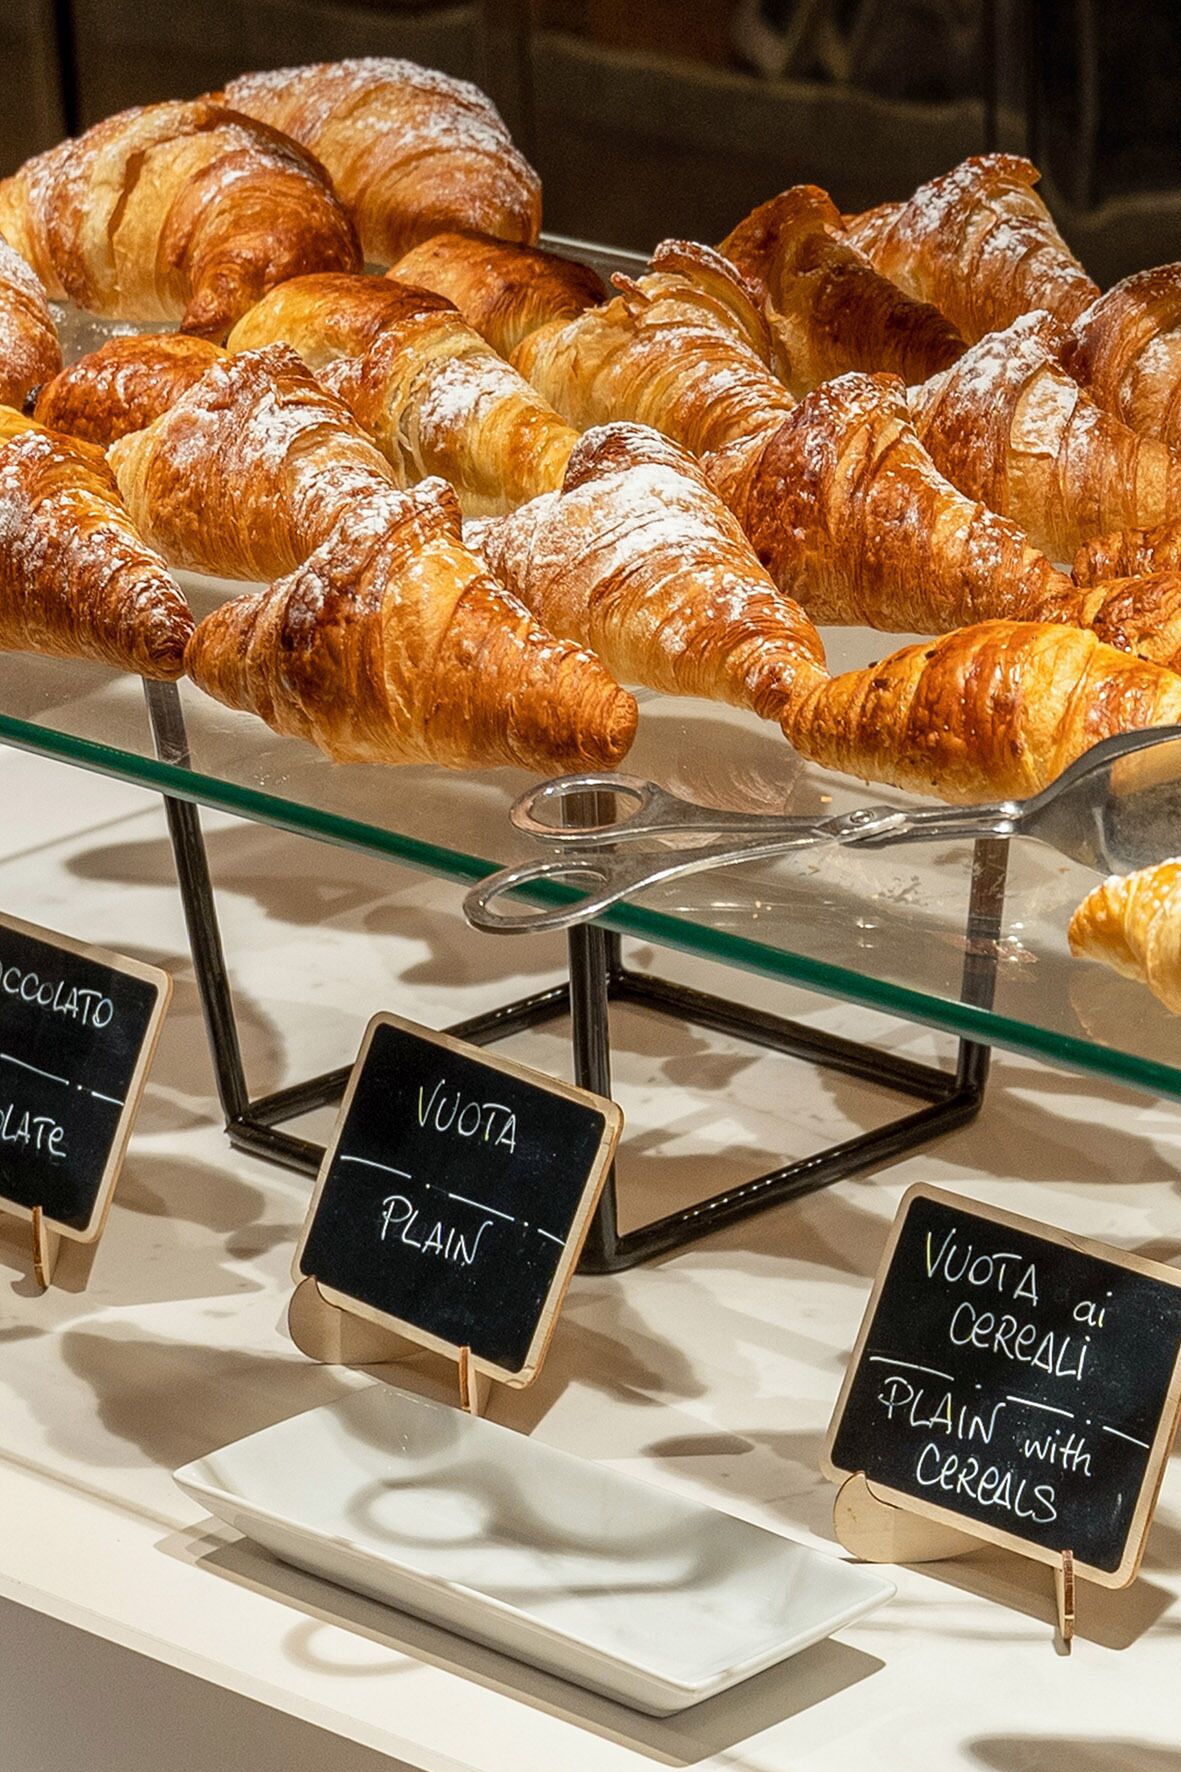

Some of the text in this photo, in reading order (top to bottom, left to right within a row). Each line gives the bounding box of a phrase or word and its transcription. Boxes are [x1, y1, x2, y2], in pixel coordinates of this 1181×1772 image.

[418, 1079, 517, 1153] VUOTA
[381, 1195, 494, 1266] PLAIN
[926, 1228, 1112, 1328] VUOTA ai
[878, 1377, 1092, 1476] PLAIN with
